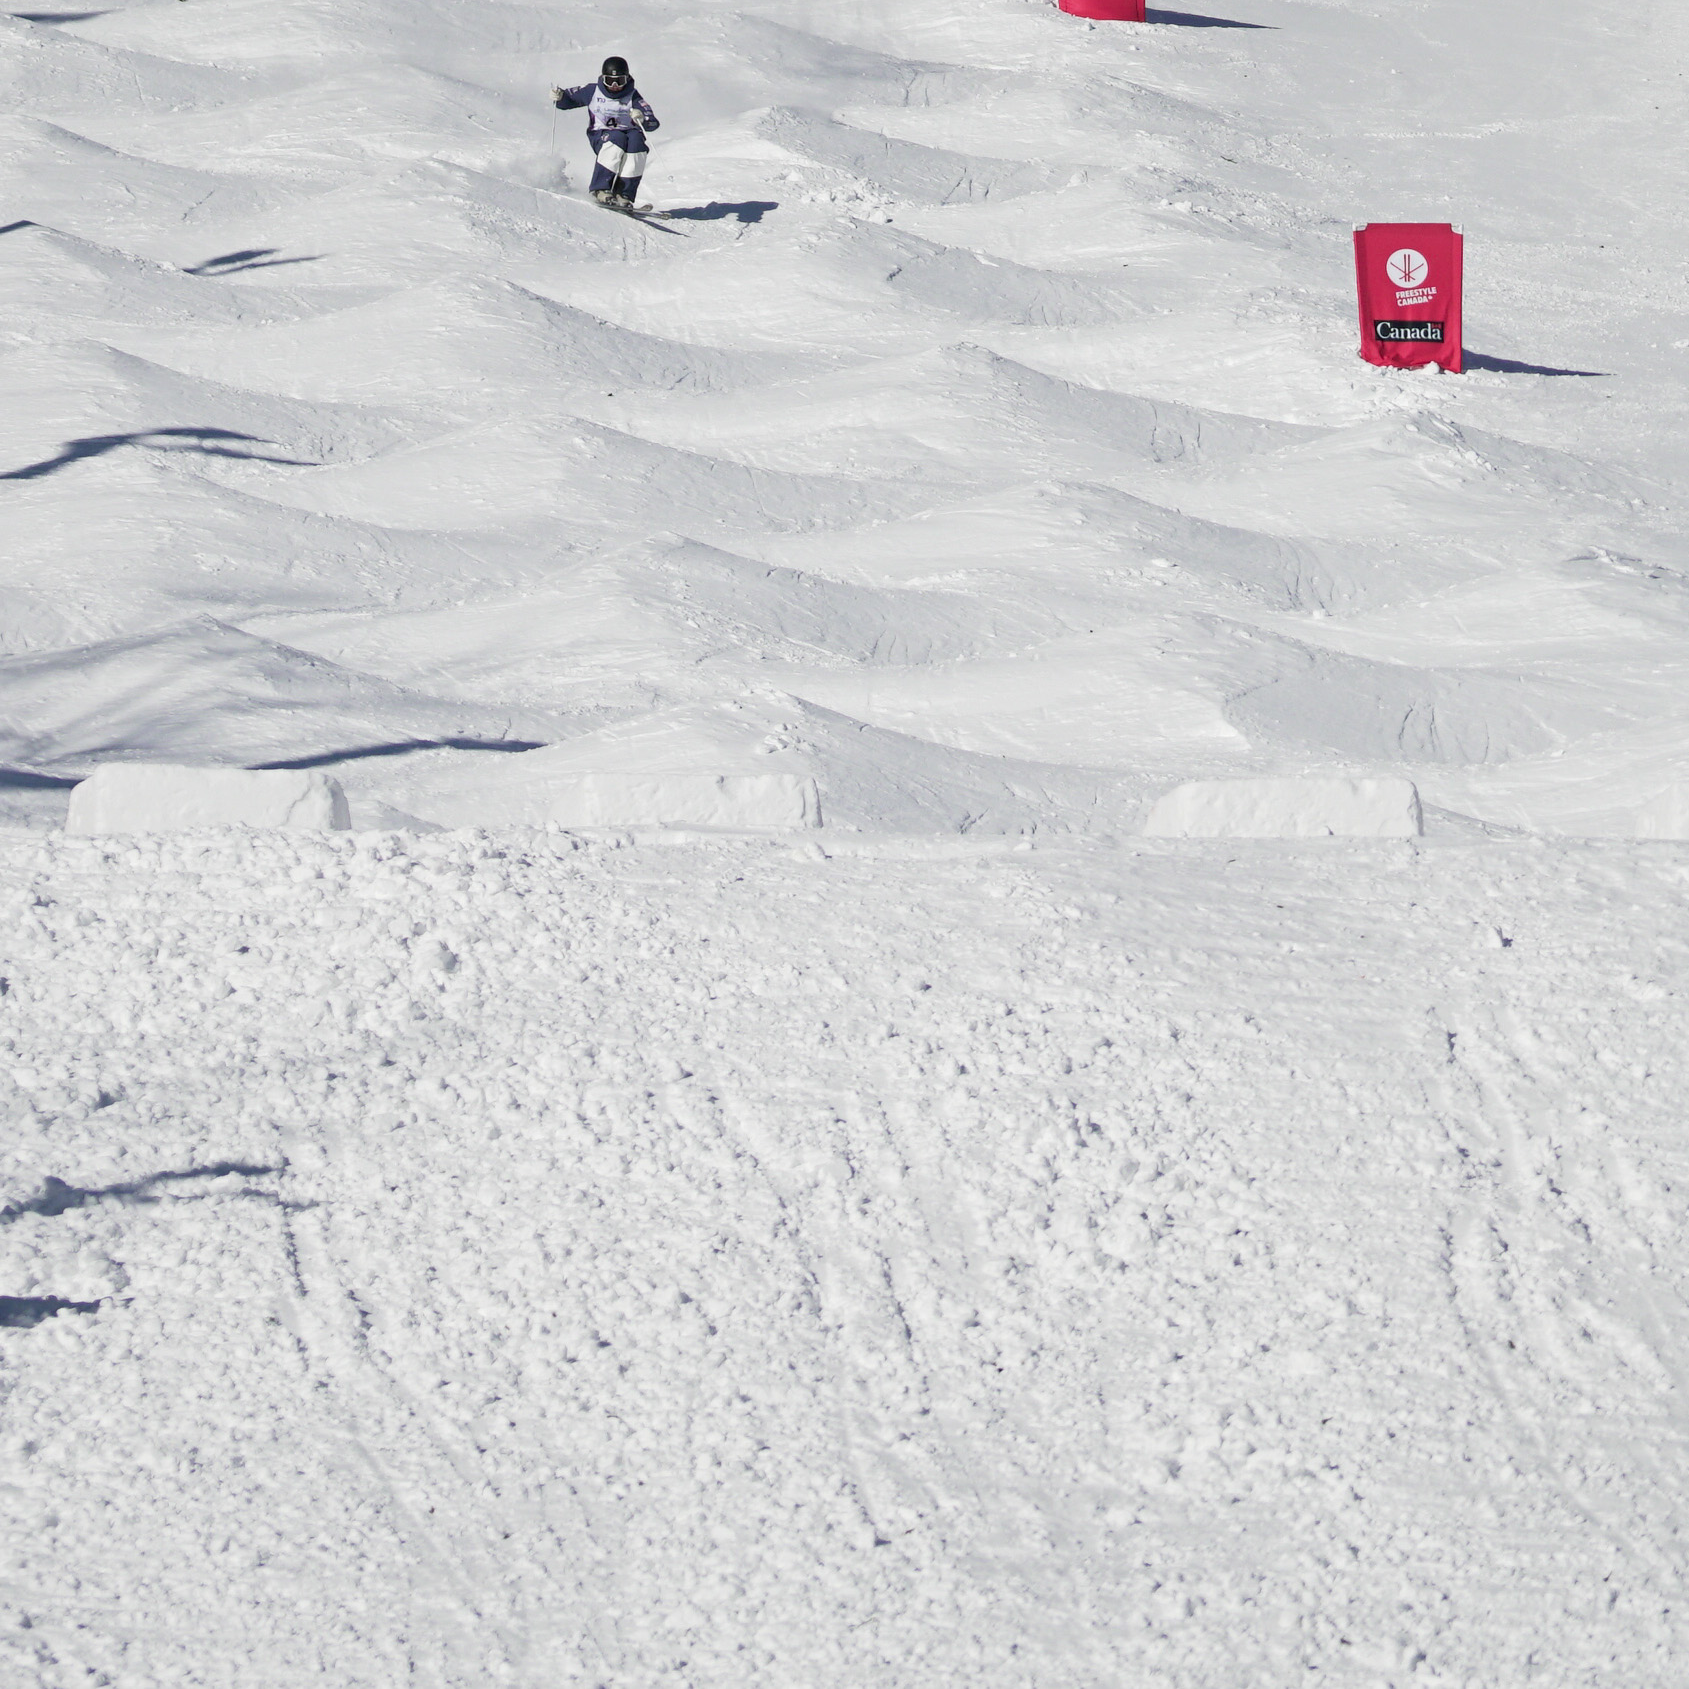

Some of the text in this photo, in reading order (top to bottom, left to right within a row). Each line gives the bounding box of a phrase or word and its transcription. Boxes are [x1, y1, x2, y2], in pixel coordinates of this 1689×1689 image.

[605, 116, 618, 128] 4
[1395, 286, 1438, 299] FREESTYLE
[1396, 295, 1429, 307] CANADA
[1376, 321, 1443, 341] Canada
